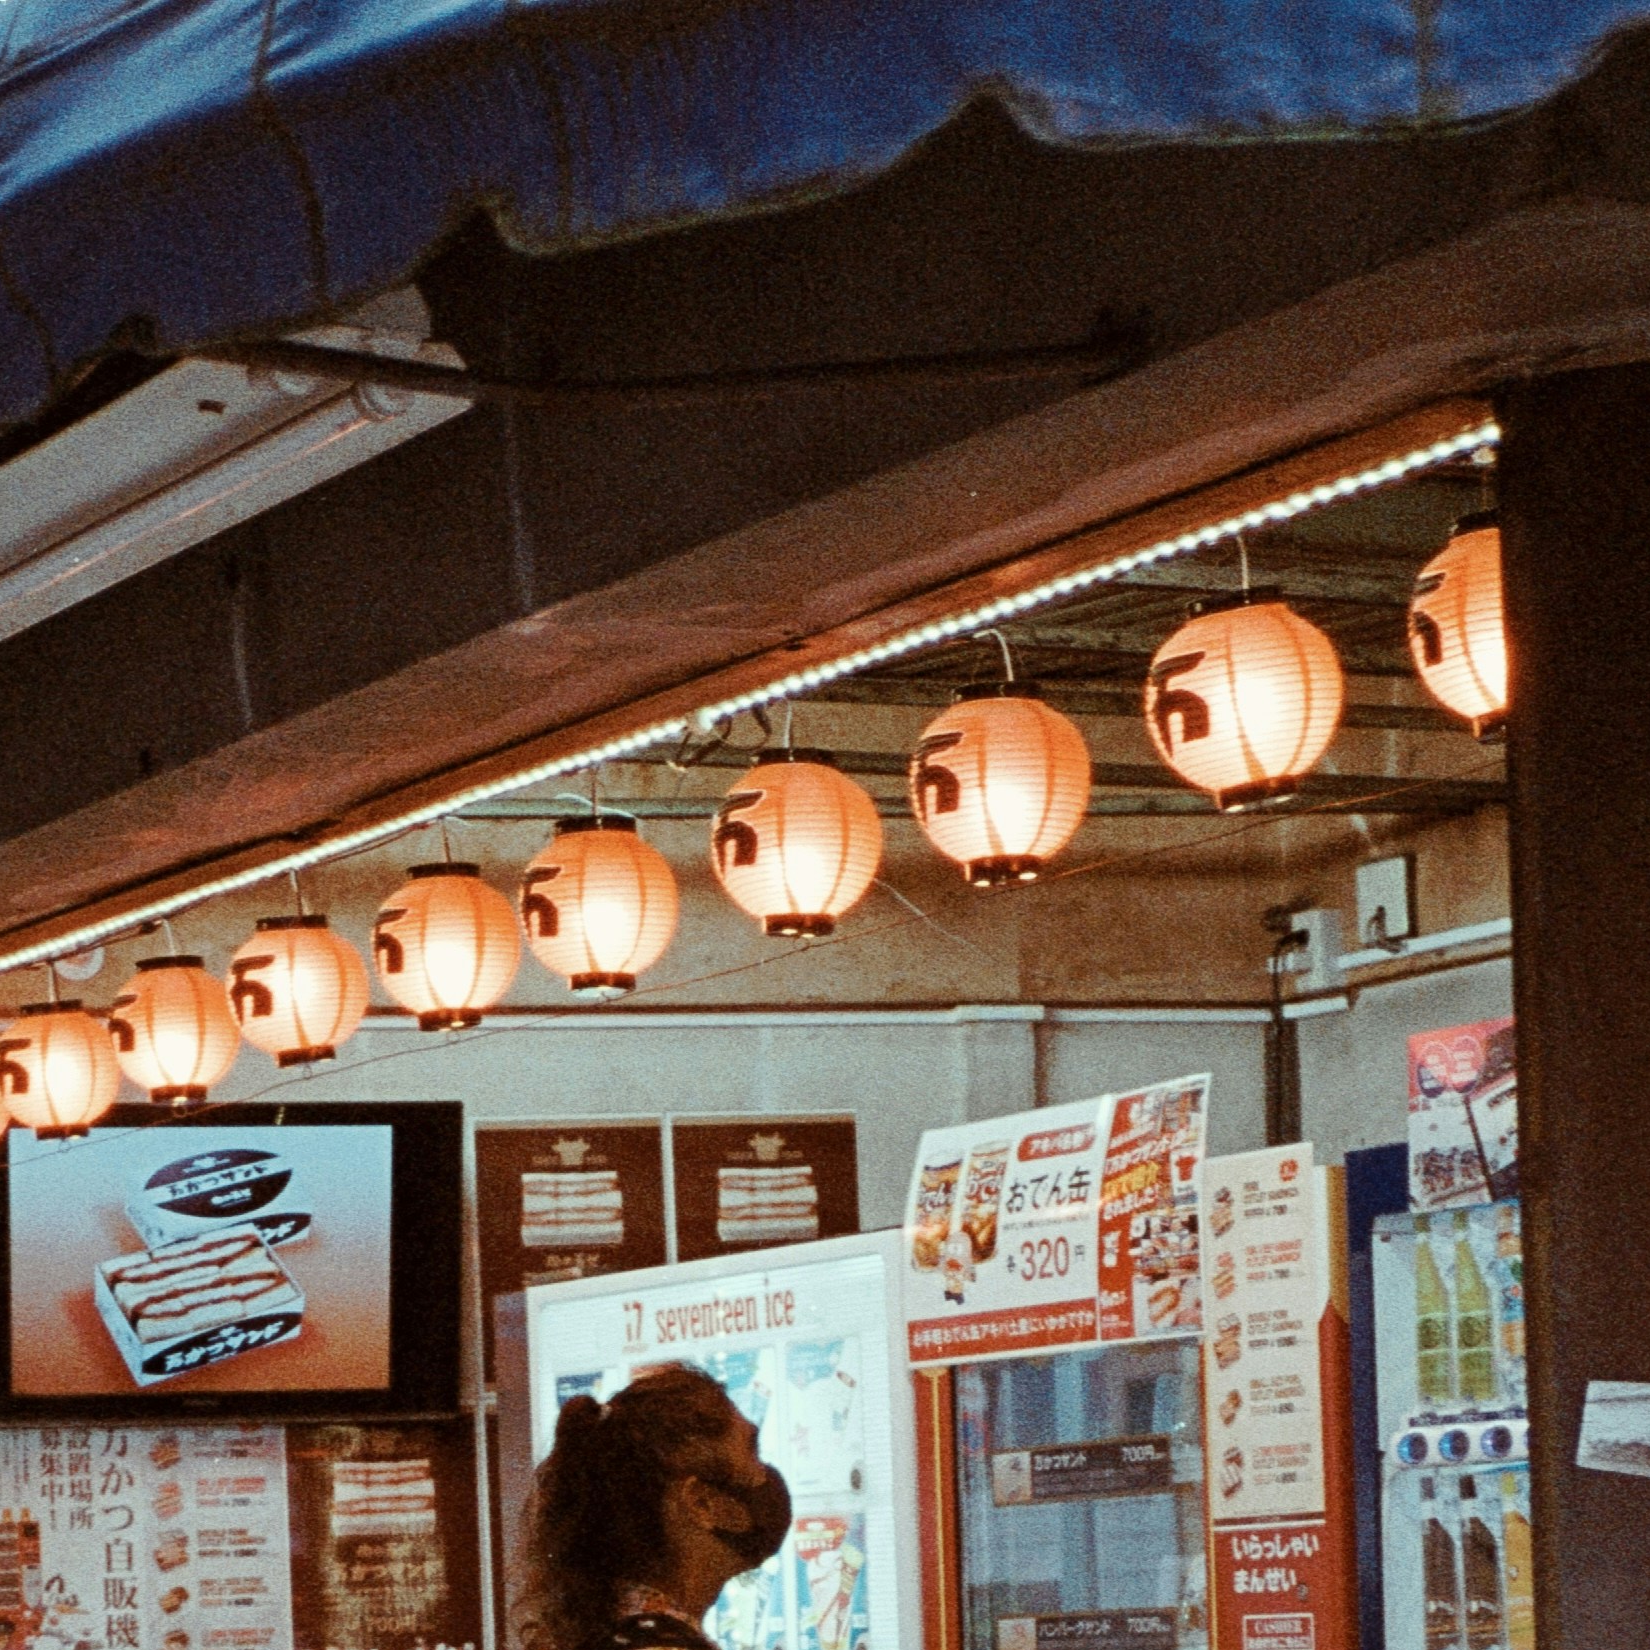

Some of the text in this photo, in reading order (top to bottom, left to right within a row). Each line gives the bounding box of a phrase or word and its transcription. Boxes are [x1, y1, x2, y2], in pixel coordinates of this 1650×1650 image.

[1006, 1166, 1091, 1214] おでん缶
[1021, 1236, 1070, 1282] 320
[656, 1296, 758, 1344] seventeen
[764, 1278, 794, 1329] ice
[1231, 1533, 1319, 1560] いらっしゃい
[1234, 1568, 1297, 1594] まんせい
[1254, 1617, 1303, 1635] CASHIER
